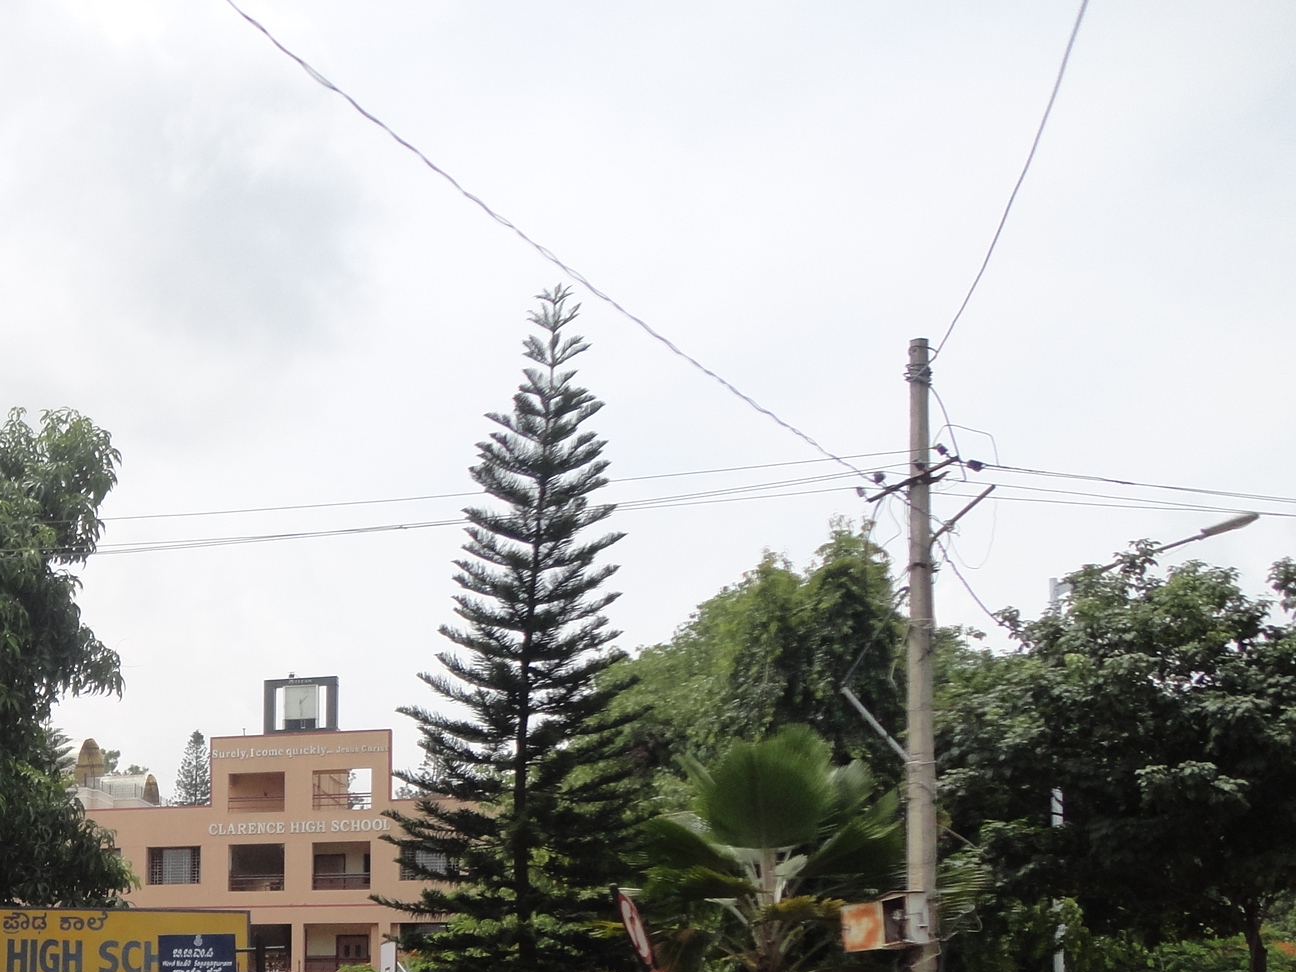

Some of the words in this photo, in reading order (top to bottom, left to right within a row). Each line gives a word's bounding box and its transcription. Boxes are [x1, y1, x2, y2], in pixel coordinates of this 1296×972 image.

[255, 749, 284, 757] come
[335, 745, 360, 754] Jesus
[361, 744, 389, 753] Christ
[208, 822, 285, 836] CLARENCE
[290, 820, 326, 834] HIGH
[331, 818, 391, 833] SCHOOL
